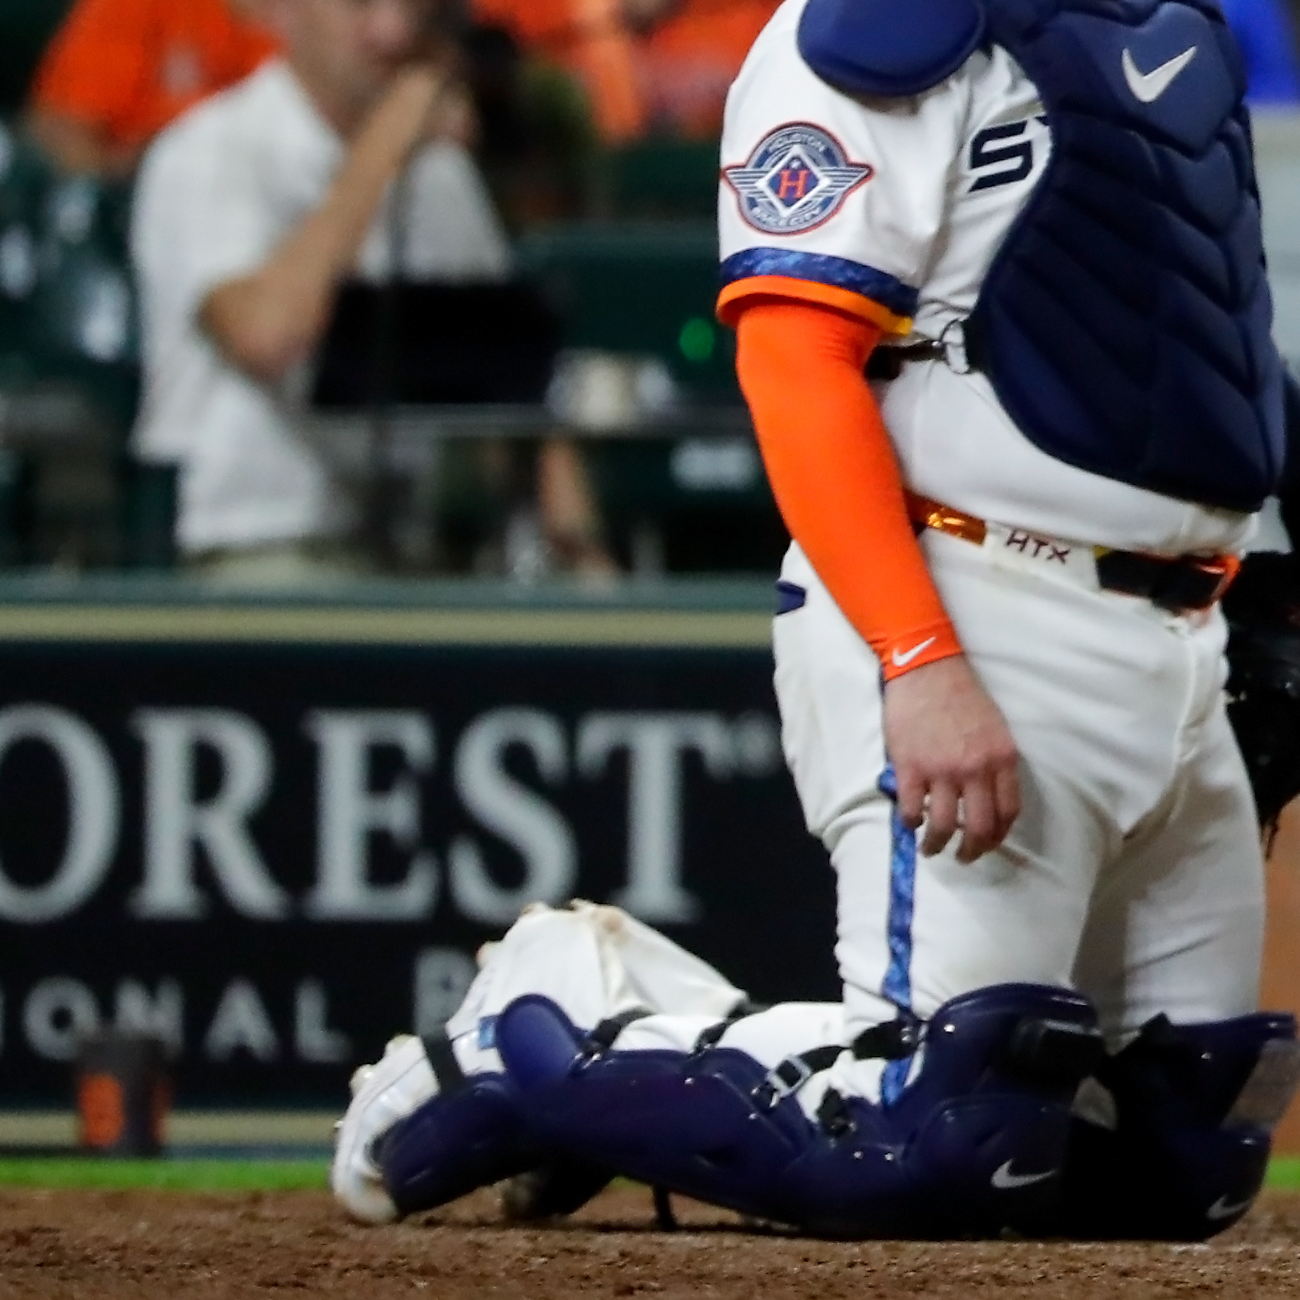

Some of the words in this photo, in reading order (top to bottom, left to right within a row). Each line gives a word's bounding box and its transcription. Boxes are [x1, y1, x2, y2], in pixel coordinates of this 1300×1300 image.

[967, 113, 1048, 194] S
[777, 169, 810, 200] H
[1005, 528, 1071, 565] HTX
[0, 973, 354, 1064] ONAL
